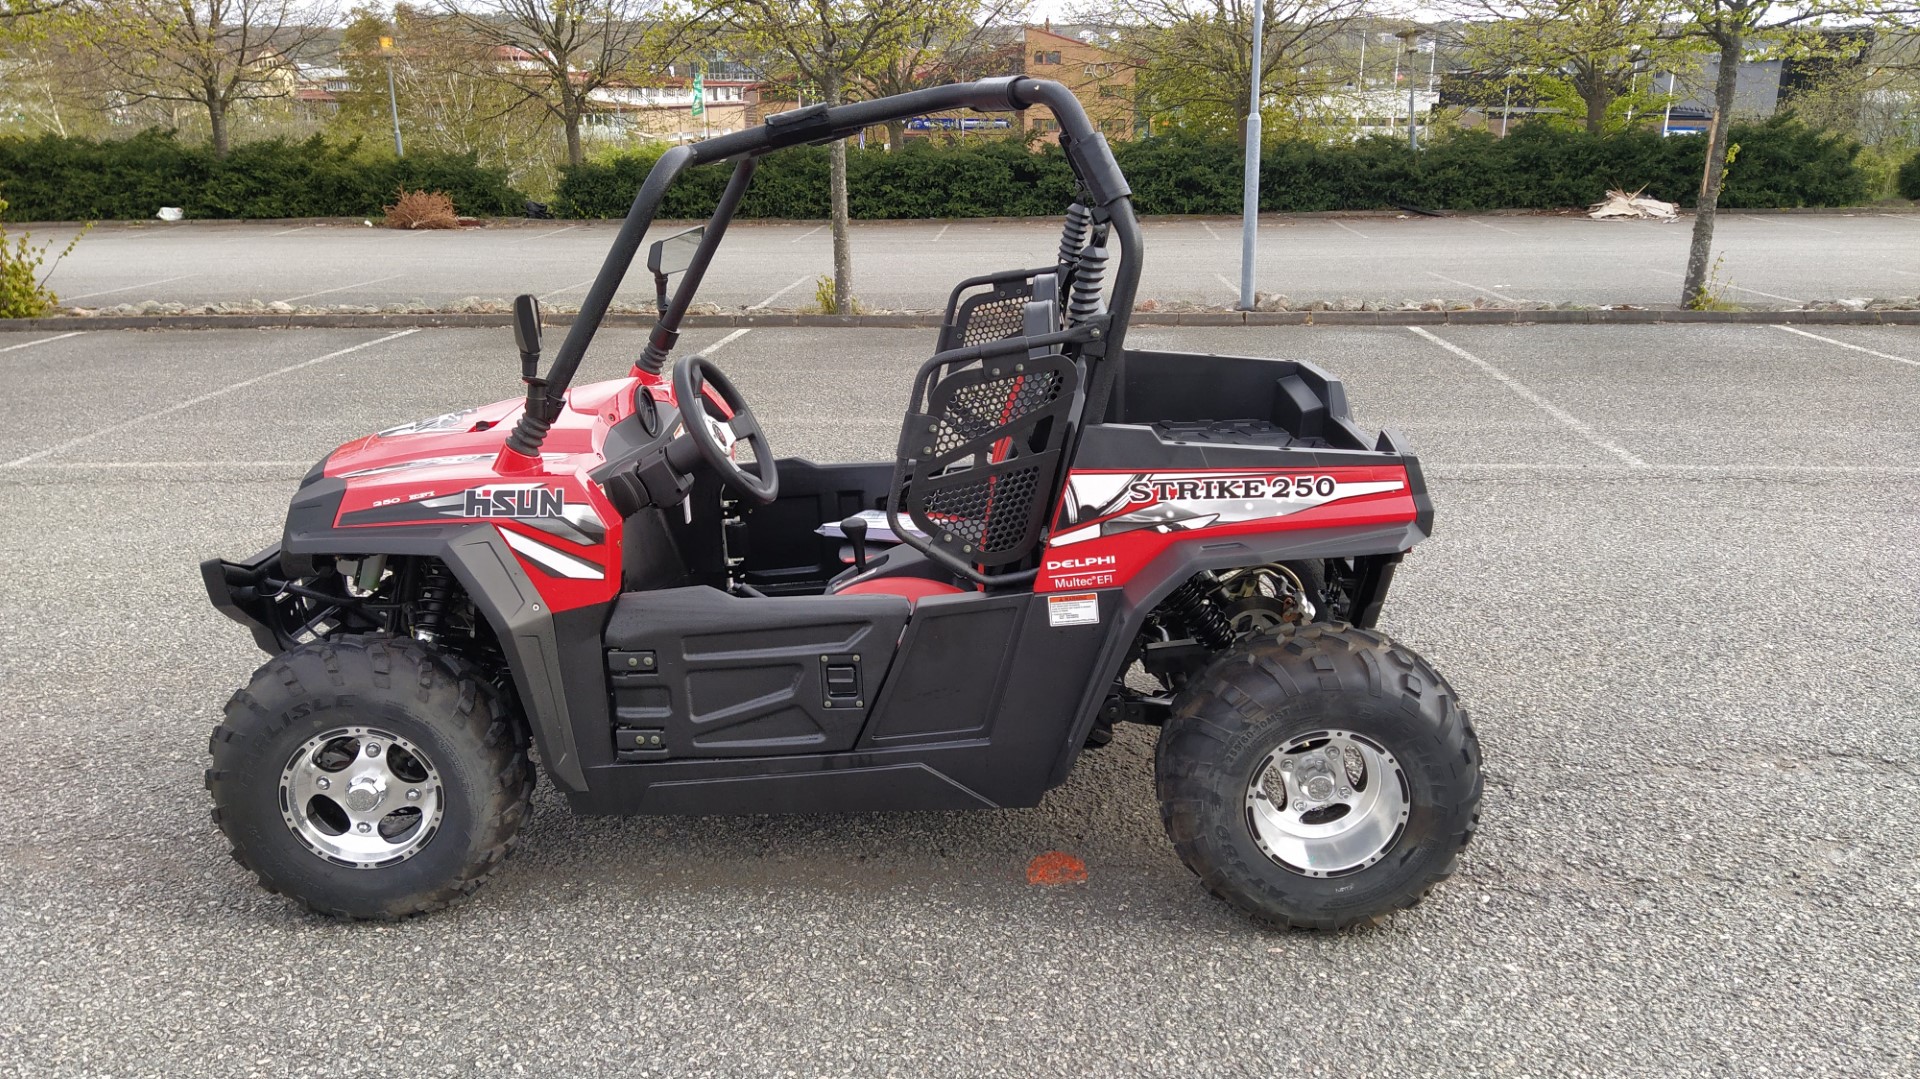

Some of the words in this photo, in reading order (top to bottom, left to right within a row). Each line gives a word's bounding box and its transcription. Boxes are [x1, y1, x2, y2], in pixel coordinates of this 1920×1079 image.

[1130, 479, 1266, 501] STRIKE
[1272, 477, 1335, 498] 250
[1046, 555, 1116, 570] DELPHI
[1097, 574, 1113, 585] EFI
